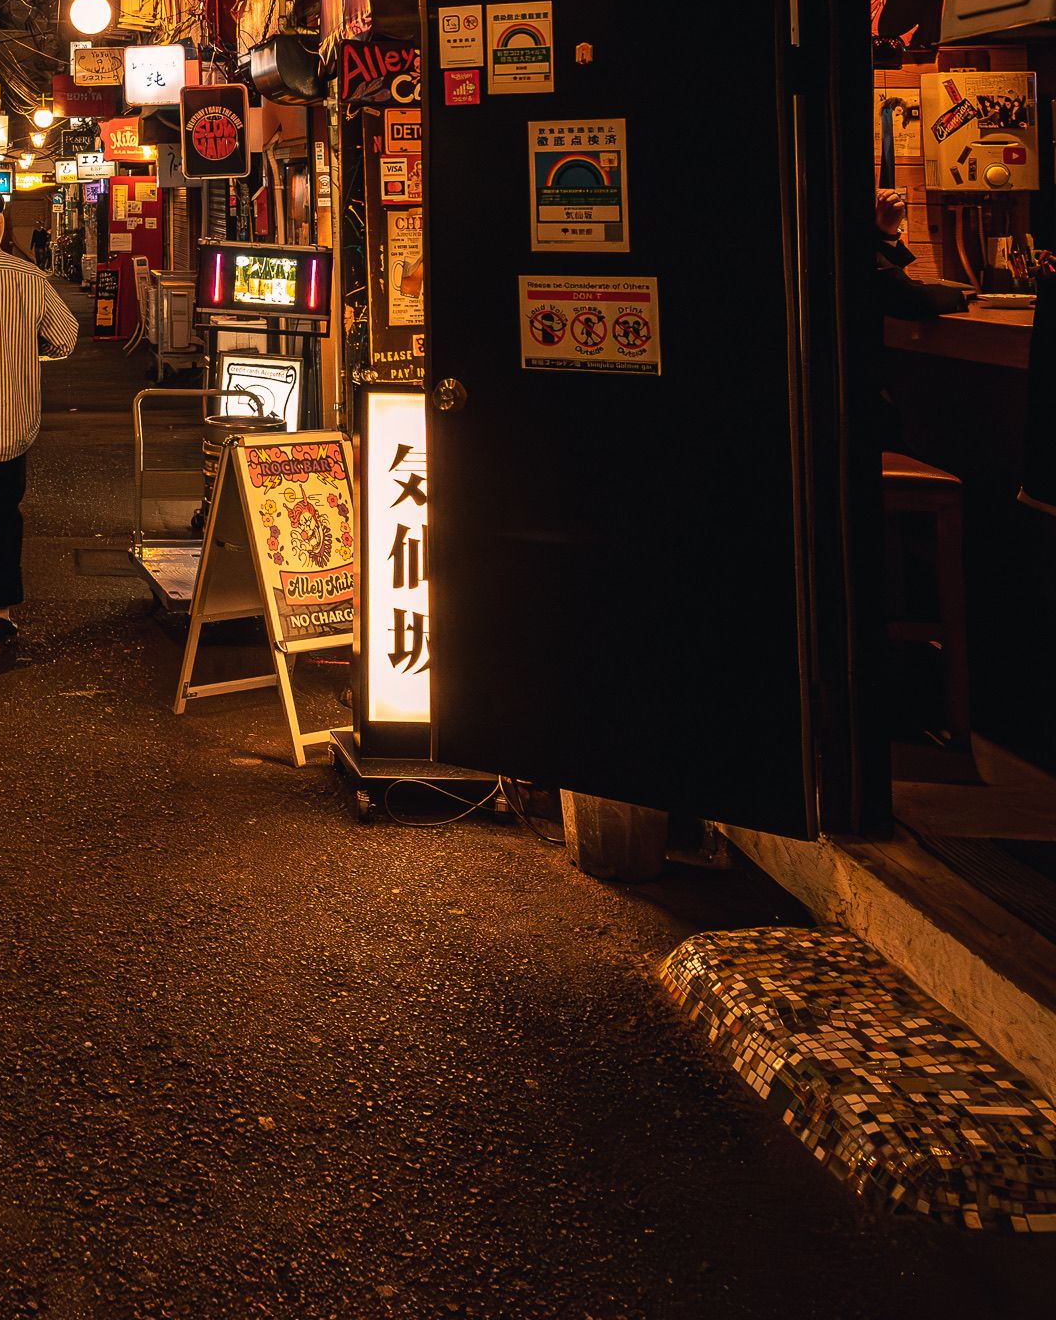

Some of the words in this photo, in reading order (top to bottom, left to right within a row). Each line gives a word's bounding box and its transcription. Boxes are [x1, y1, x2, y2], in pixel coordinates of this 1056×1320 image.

[342, 43, 415, 100] Alley
[935, 100, 972, 141] Champion
[195, 118, 236, 138] SLOW
[394, 125, 421, 139] DET
[82, 155, 104, 164] エス
[622, 282, 650, 290] Others
[617, 306, 643, 314] Drink
[374, 351, 412, 363] PLEASE
[575, 345, 604, 356] Outside
[617, 346, 648, 358] Outside
[390, 369, 410, 379] PAY
[260, 460, 299, 476] ROCK
[304, 458, 331, 473] BAR
[287, 576, 324, 600] Alley
[290, 613, 310, 629] NO
